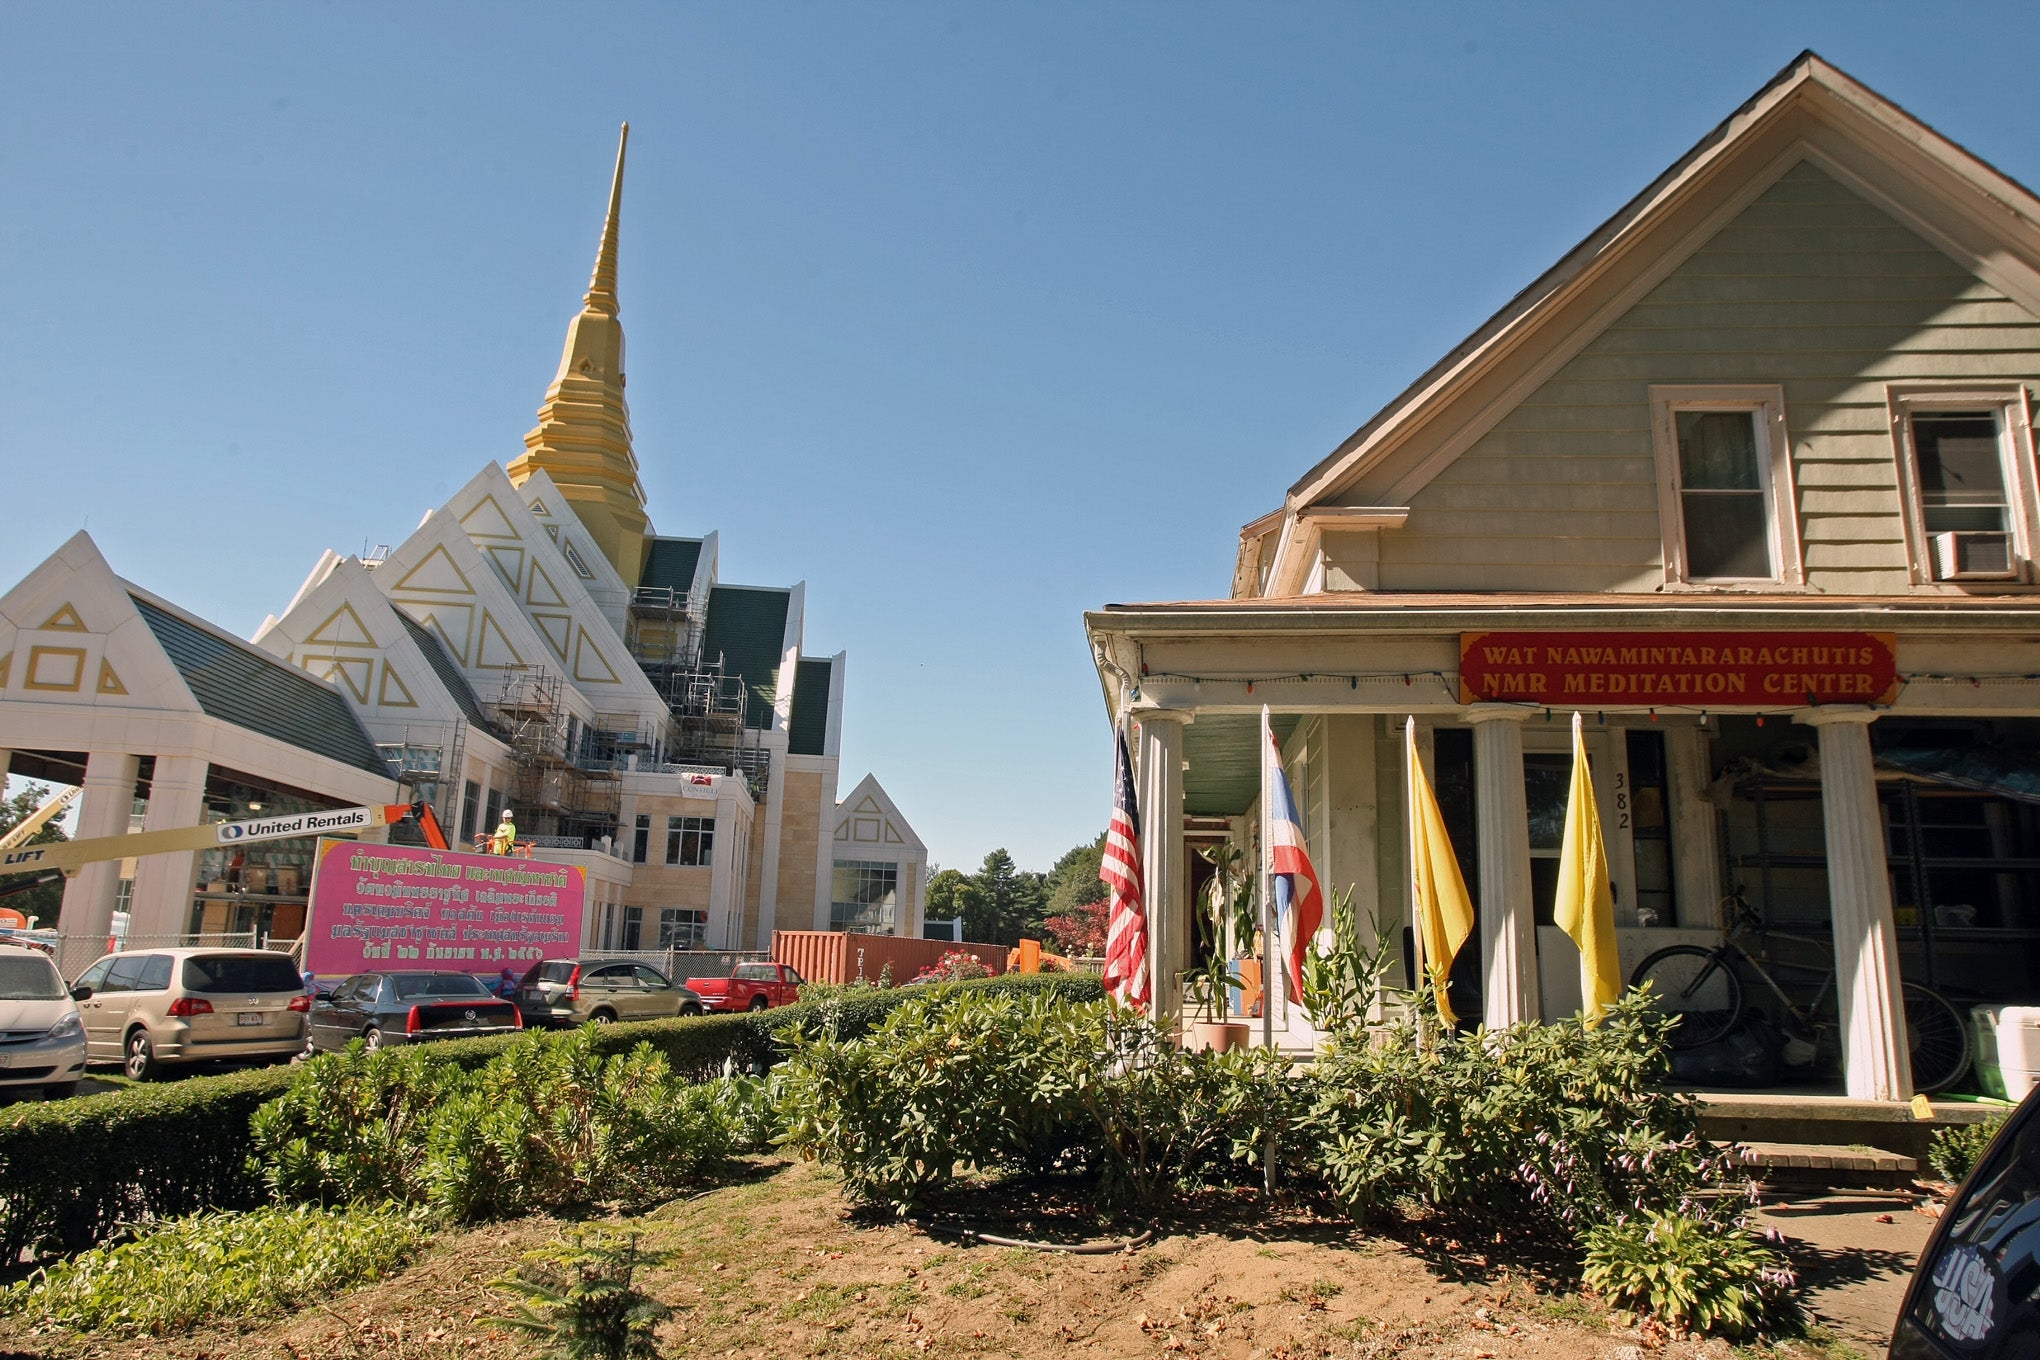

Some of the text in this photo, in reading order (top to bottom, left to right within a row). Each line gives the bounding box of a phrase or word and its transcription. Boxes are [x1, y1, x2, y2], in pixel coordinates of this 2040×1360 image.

[1482, 646, 1874, 665] WAT NAWAMINTARARACHUTIS
[1483, 673, 1874, 694] NMR MEDITATION CENTER
[1615, 773, 1629, 829] 382
[248, 812, 364, 836] United Rentals
[4, 849, 46, 865] LIFT
